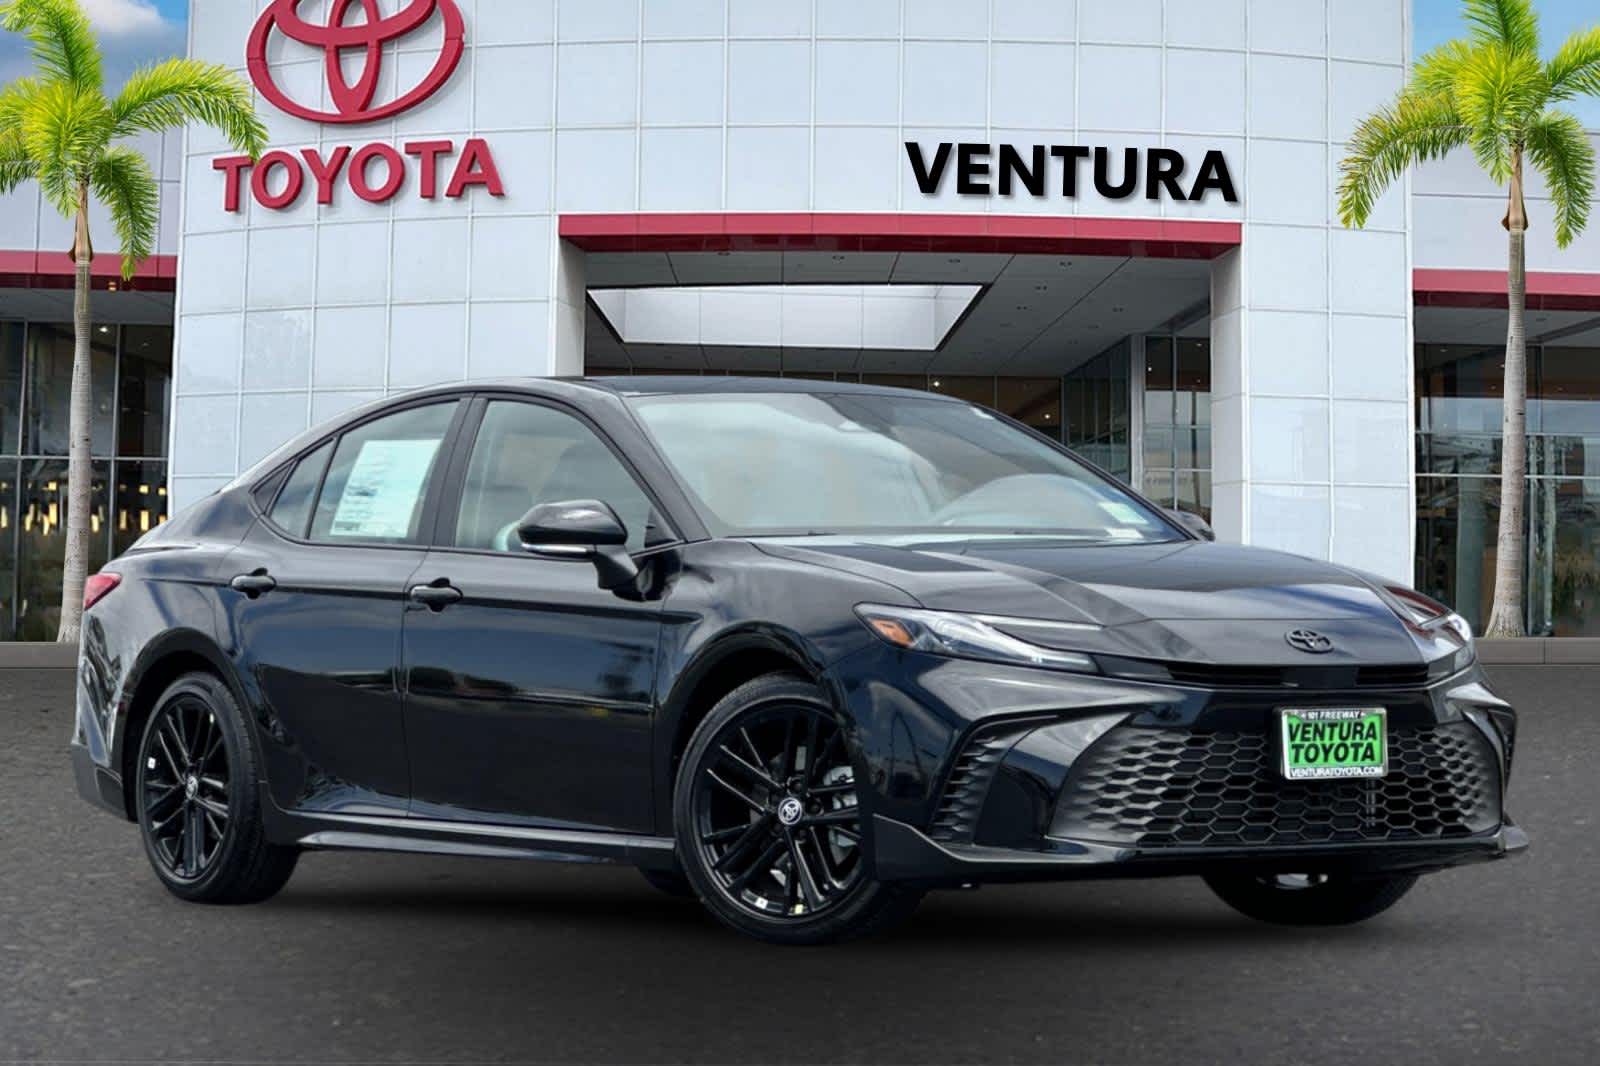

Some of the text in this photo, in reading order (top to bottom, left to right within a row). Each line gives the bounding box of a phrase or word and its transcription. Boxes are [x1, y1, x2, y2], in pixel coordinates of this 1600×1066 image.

[213, 139, 504, 212] TOYOTA
[905, 142, 1238, 202] VENTURA
[1307, 711, 1360, 720] 101 FREEWAY
[1288, 721, 1377, 742] VENTURA
[1291, 742, 1375, 763] TOYOTA
[1290, 766, 1382, 777] VENTURATOYOTA.COM
